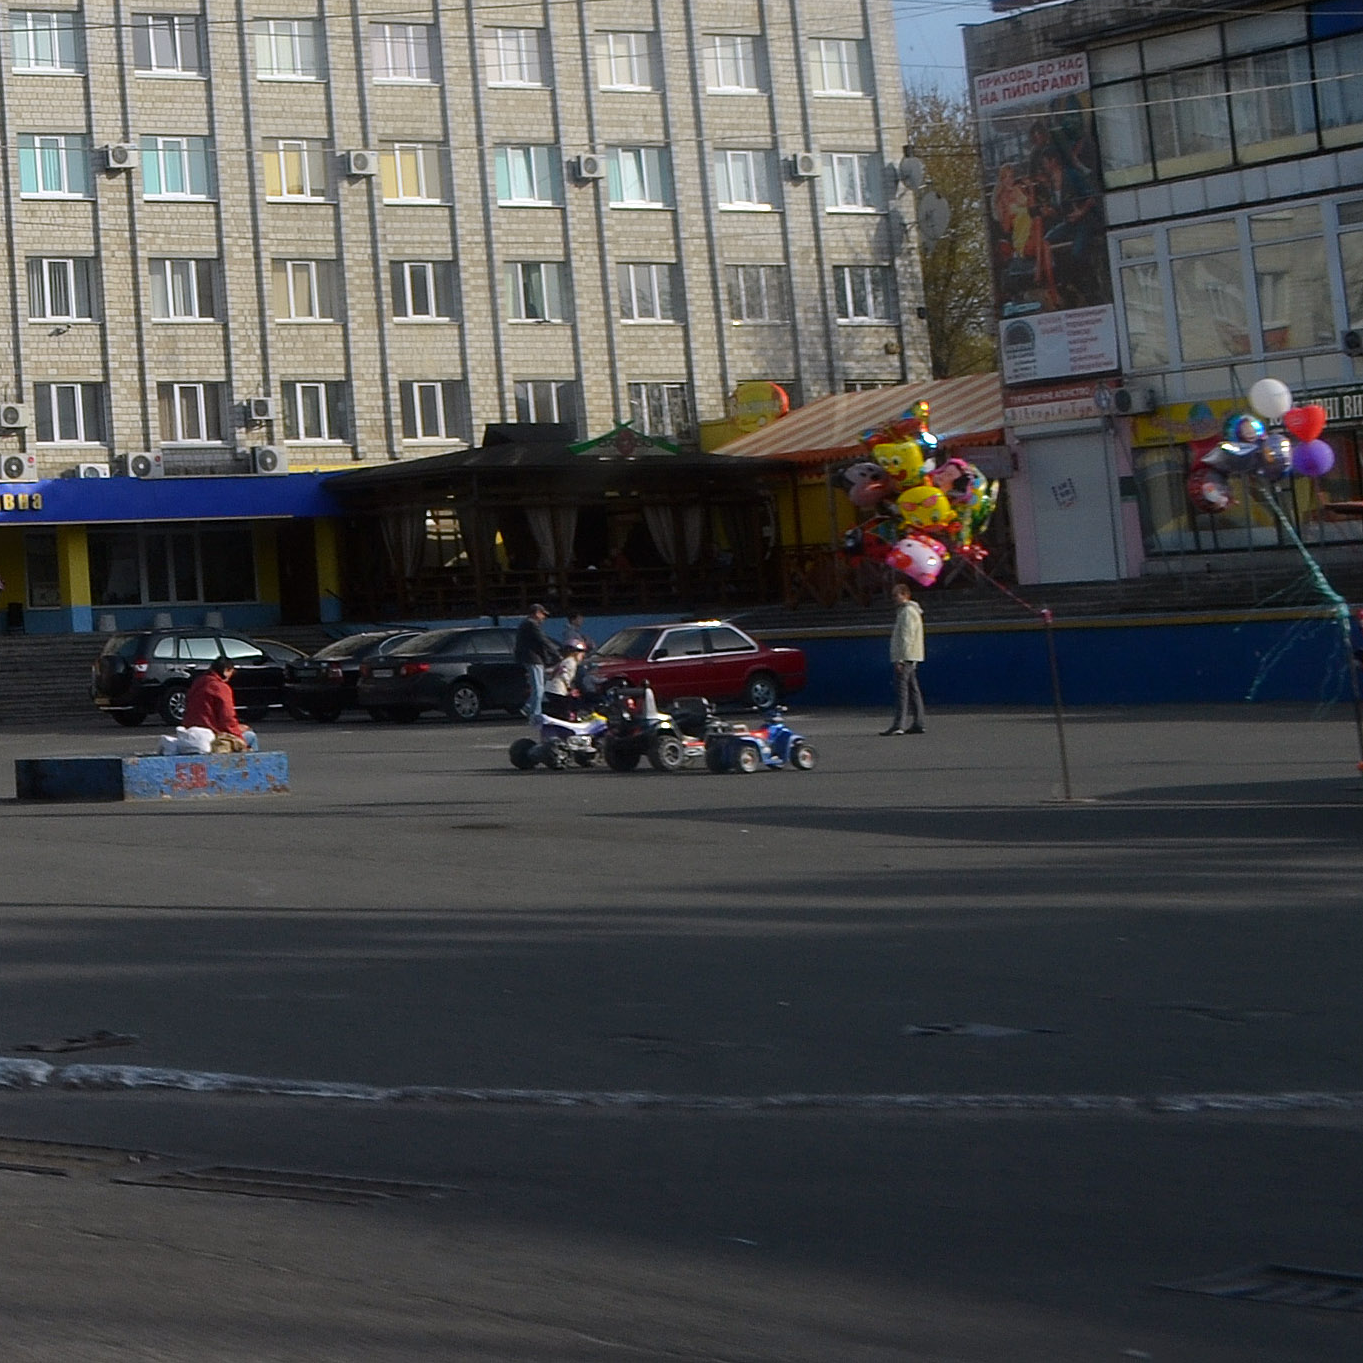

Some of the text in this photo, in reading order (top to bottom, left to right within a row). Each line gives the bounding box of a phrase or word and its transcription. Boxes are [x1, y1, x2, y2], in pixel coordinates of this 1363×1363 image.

[978, 57, 1083, 89] ПРИХОДЬ ДО НАС
[980, 72, 1085, 106] НА ПИЛОРАМУ!
